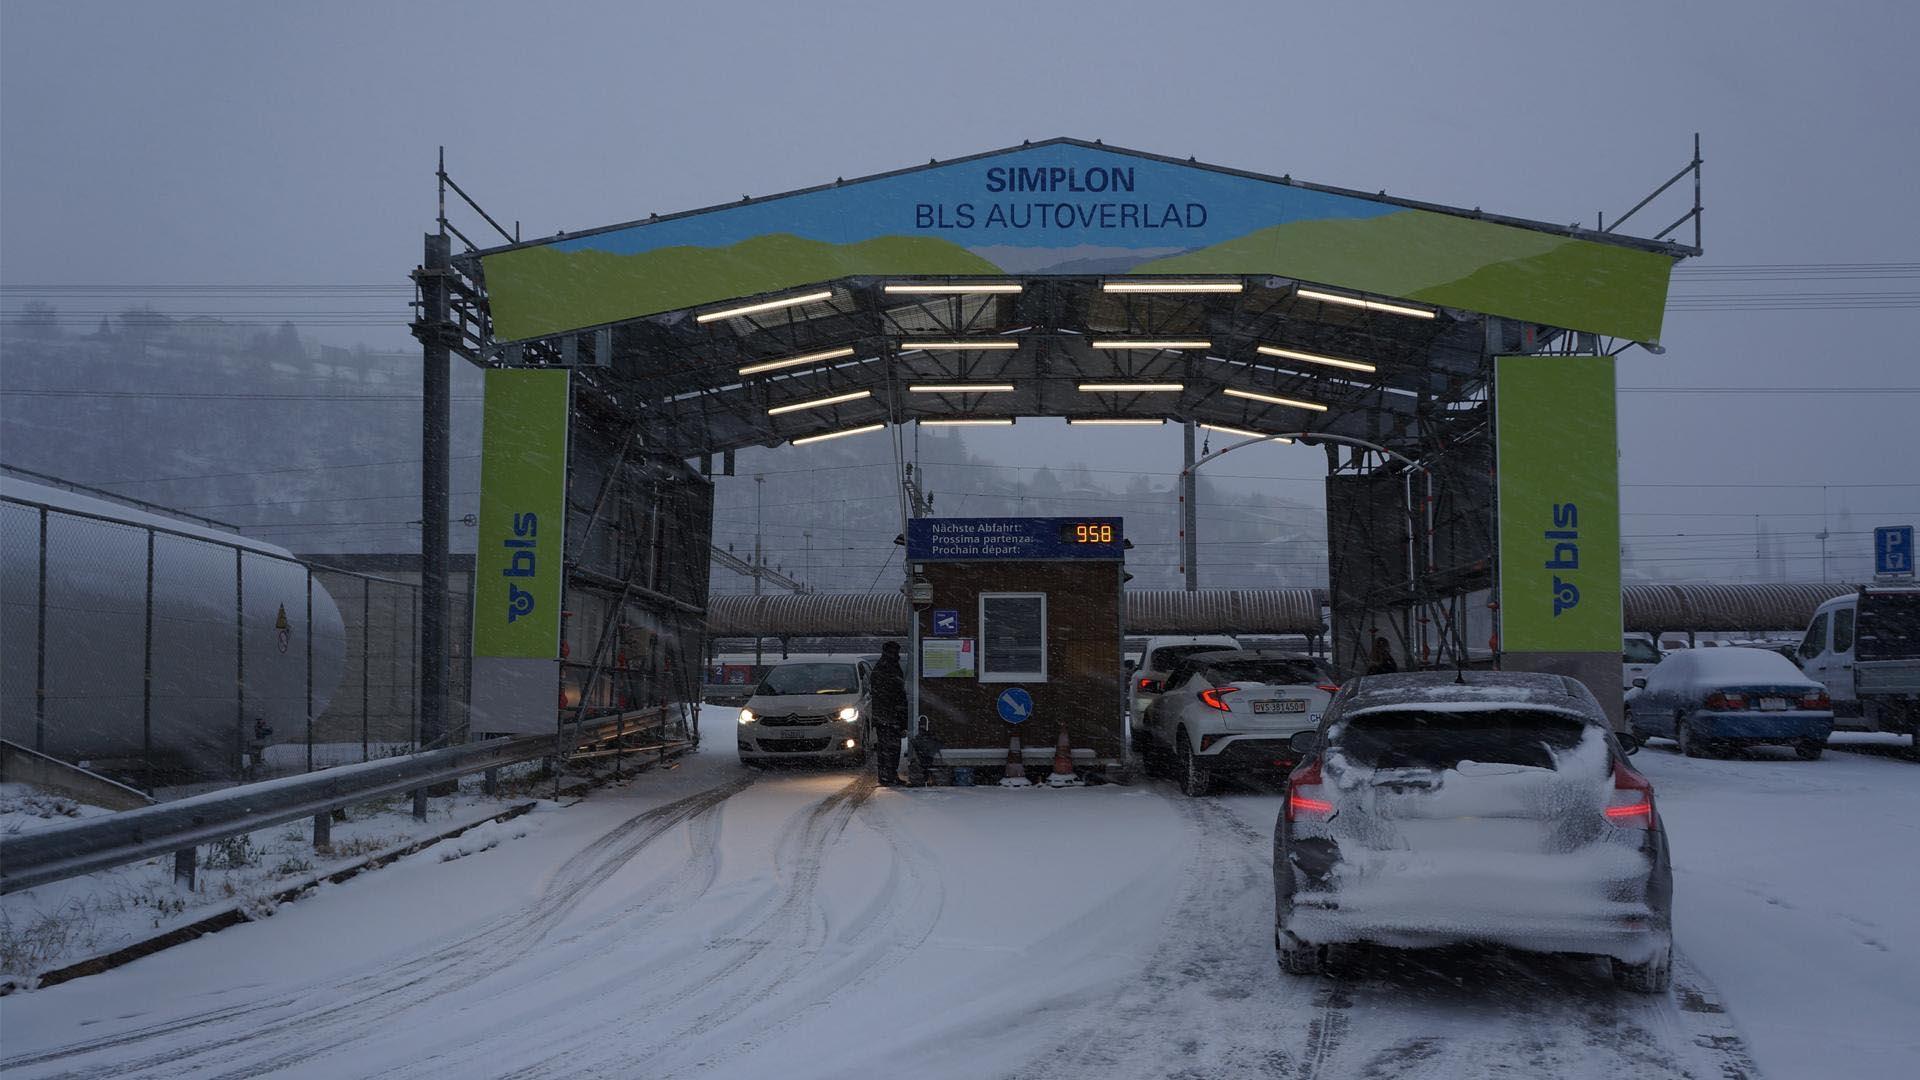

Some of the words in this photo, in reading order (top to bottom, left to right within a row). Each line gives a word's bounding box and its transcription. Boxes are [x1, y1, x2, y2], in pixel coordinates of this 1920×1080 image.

[986, 167, 1135, 193] SIMPLON
[915, 203, 975, 229] BLS
[984, 203, 1208, 229] AUTOVERLAD
[932, 523, 975, 533] Nächste
[977, 523, 1023, 533] Abfahrt:
[1076, 525, 1111, 543] 958
[1544, 502, 1579, 570] bls
[503, 512, 538, 577] bls
[932, 535, 980, 544] Prossima
[983, 535, 1034, 546] partenza:
[932, 545, 978, 554] Prochain
[982, 545, 1021, 556] départ:
[1886, 531, 1902, 553] P
[1310, 714, 1321, 723] CH
